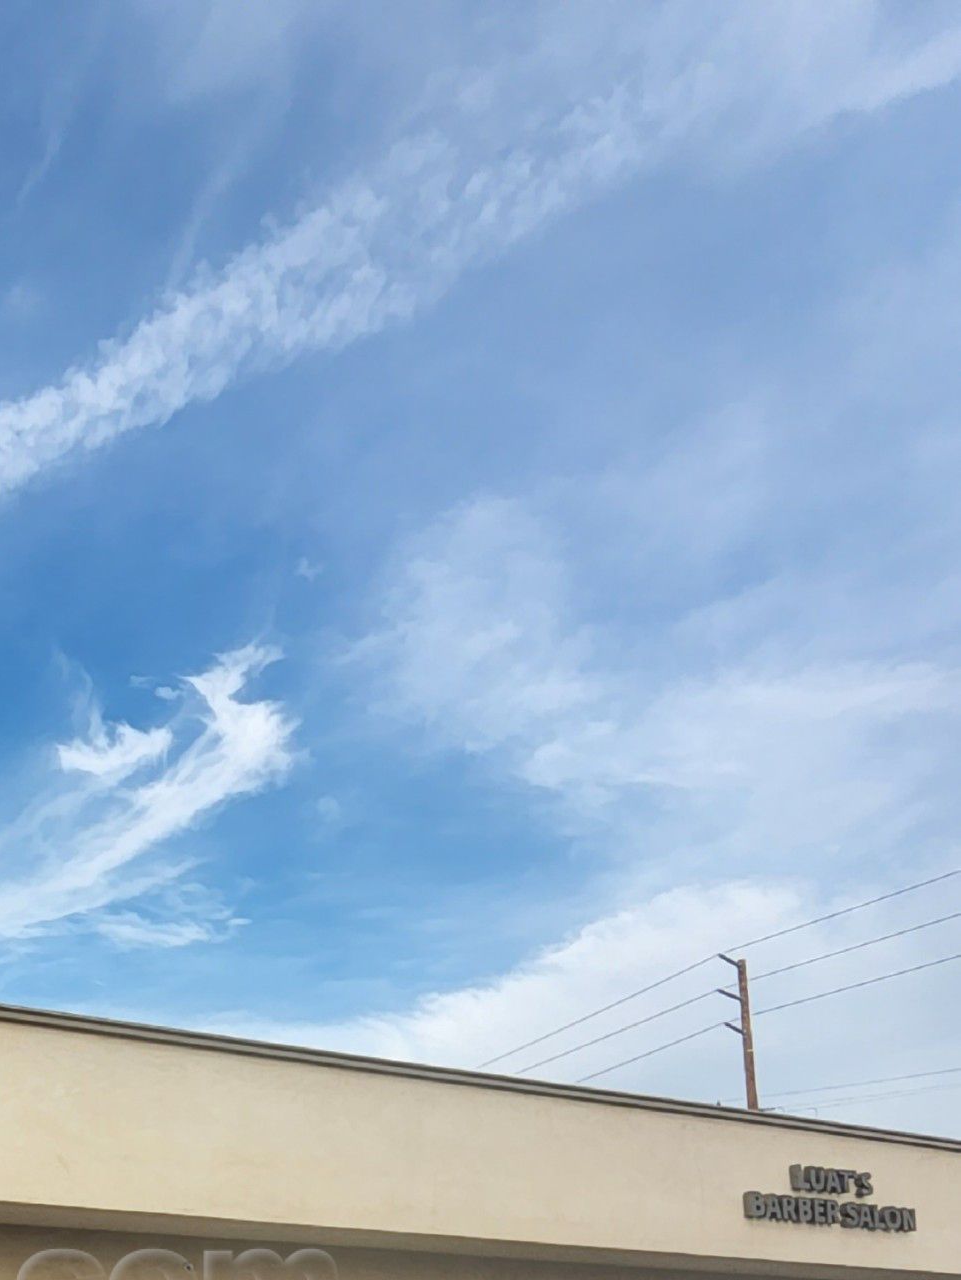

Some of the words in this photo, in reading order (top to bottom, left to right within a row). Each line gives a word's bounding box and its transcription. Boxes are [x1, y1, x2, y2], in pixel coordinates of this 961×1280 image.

[789, 1164, 874, 1198] LUAT'S
[743, 1191, 840, 1225] BARBER
[840, 1201, 917, 1232] SALON
